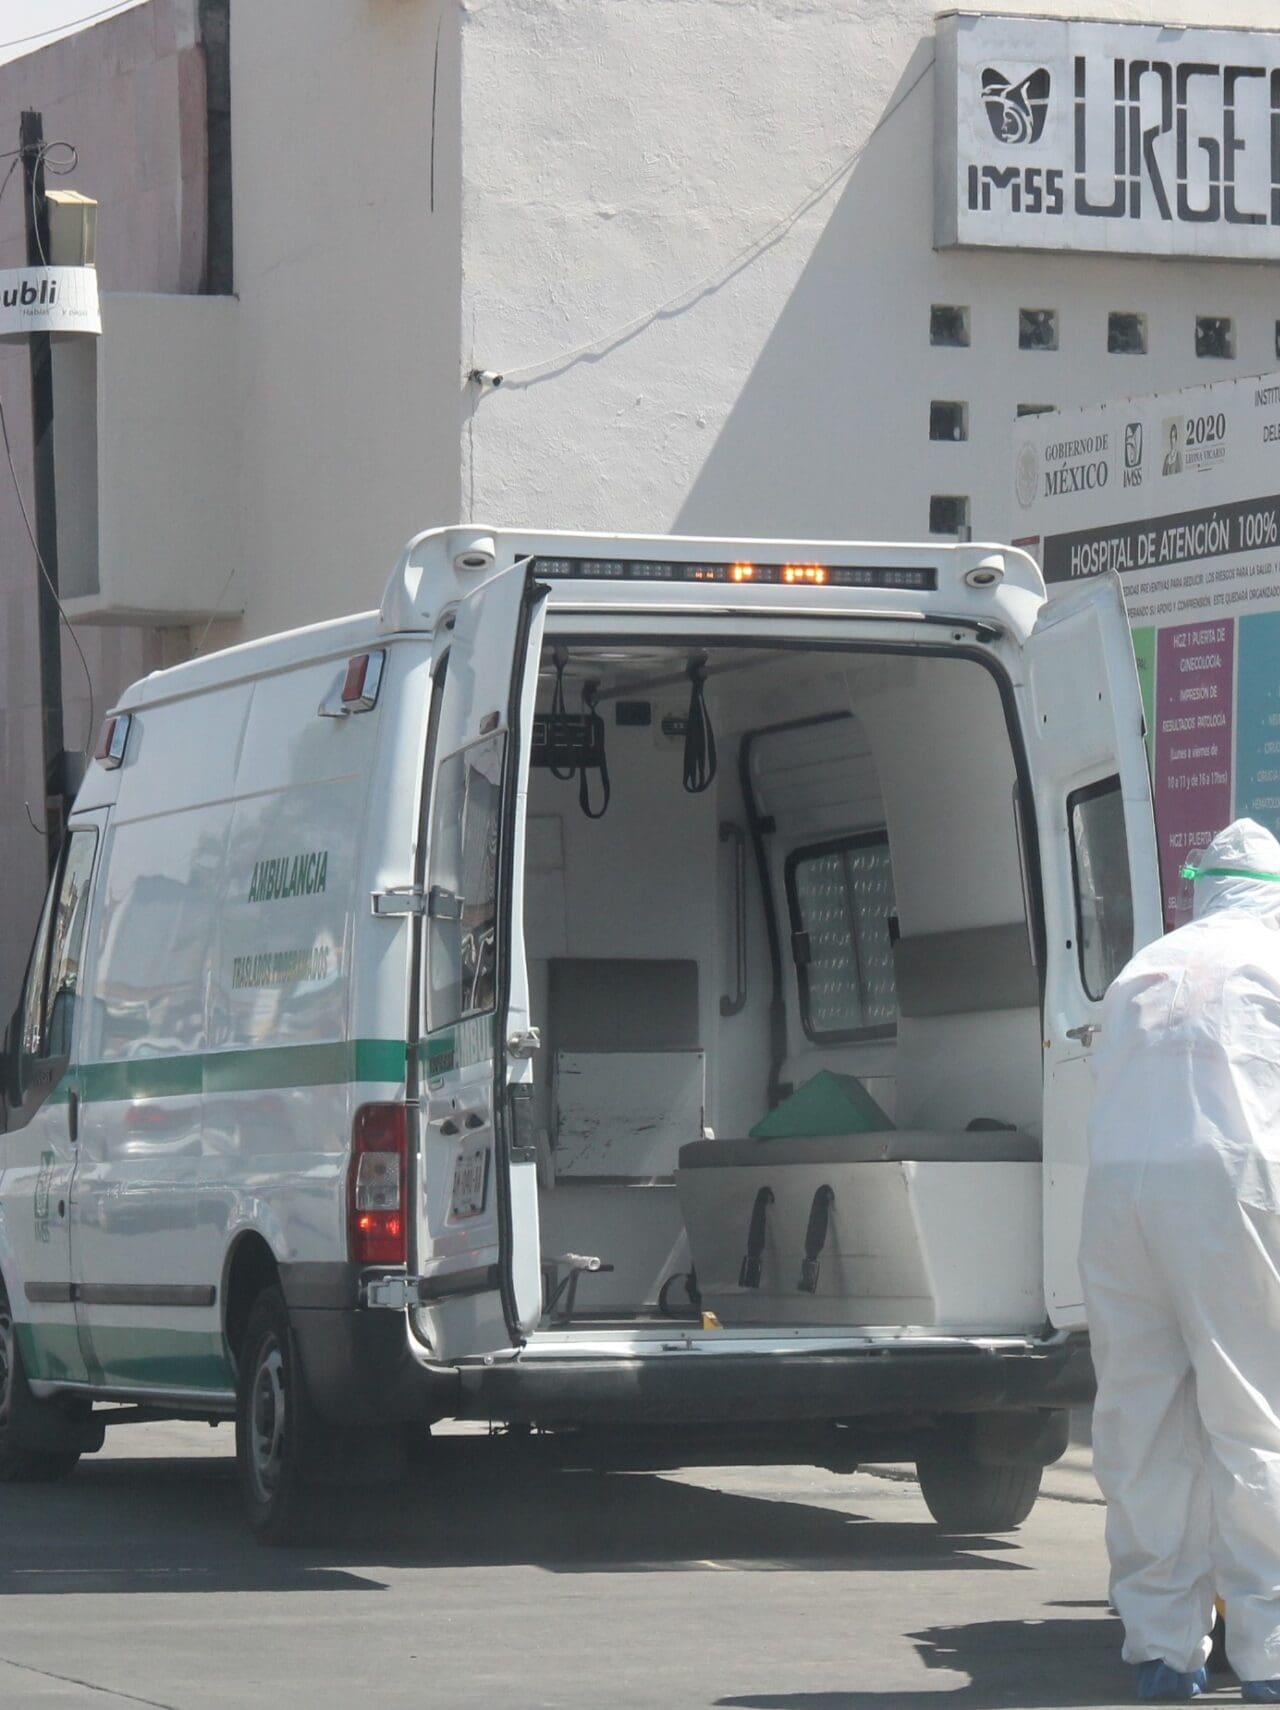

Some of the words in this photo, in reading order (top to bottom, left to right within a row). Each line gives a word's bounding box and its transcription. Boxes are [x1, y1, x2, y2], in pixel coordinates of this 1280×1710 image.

[968, 164, 1064, 216] IMSS
[0, 280, 57, 308] ubli
[1186, 413, 1226, 446] 2020
[1045, 435, 1092, 461] GOBIERNO
[1094, 433, 1109, 451] DE
[1044, 461, 1109, 497] MÉXICO
[1123, 467, 1142, 488] IMSS
[1071, 537, 1134, 577] HOSPITAL
[1138, 531, 1156, 563] DE
[1158, 512, 1230, 562] ATENCIÓN
[1238, 509, 1277, 548] 100%
[1192, 629, 1216, 645] PUERTA
[1217, 627, 1226, 642] DE
[1210, 685, 1218, 698] DE
[1189, 831, 1212, 846] PUERTA
[247, 850, 329, 904] AMBULANCIA
